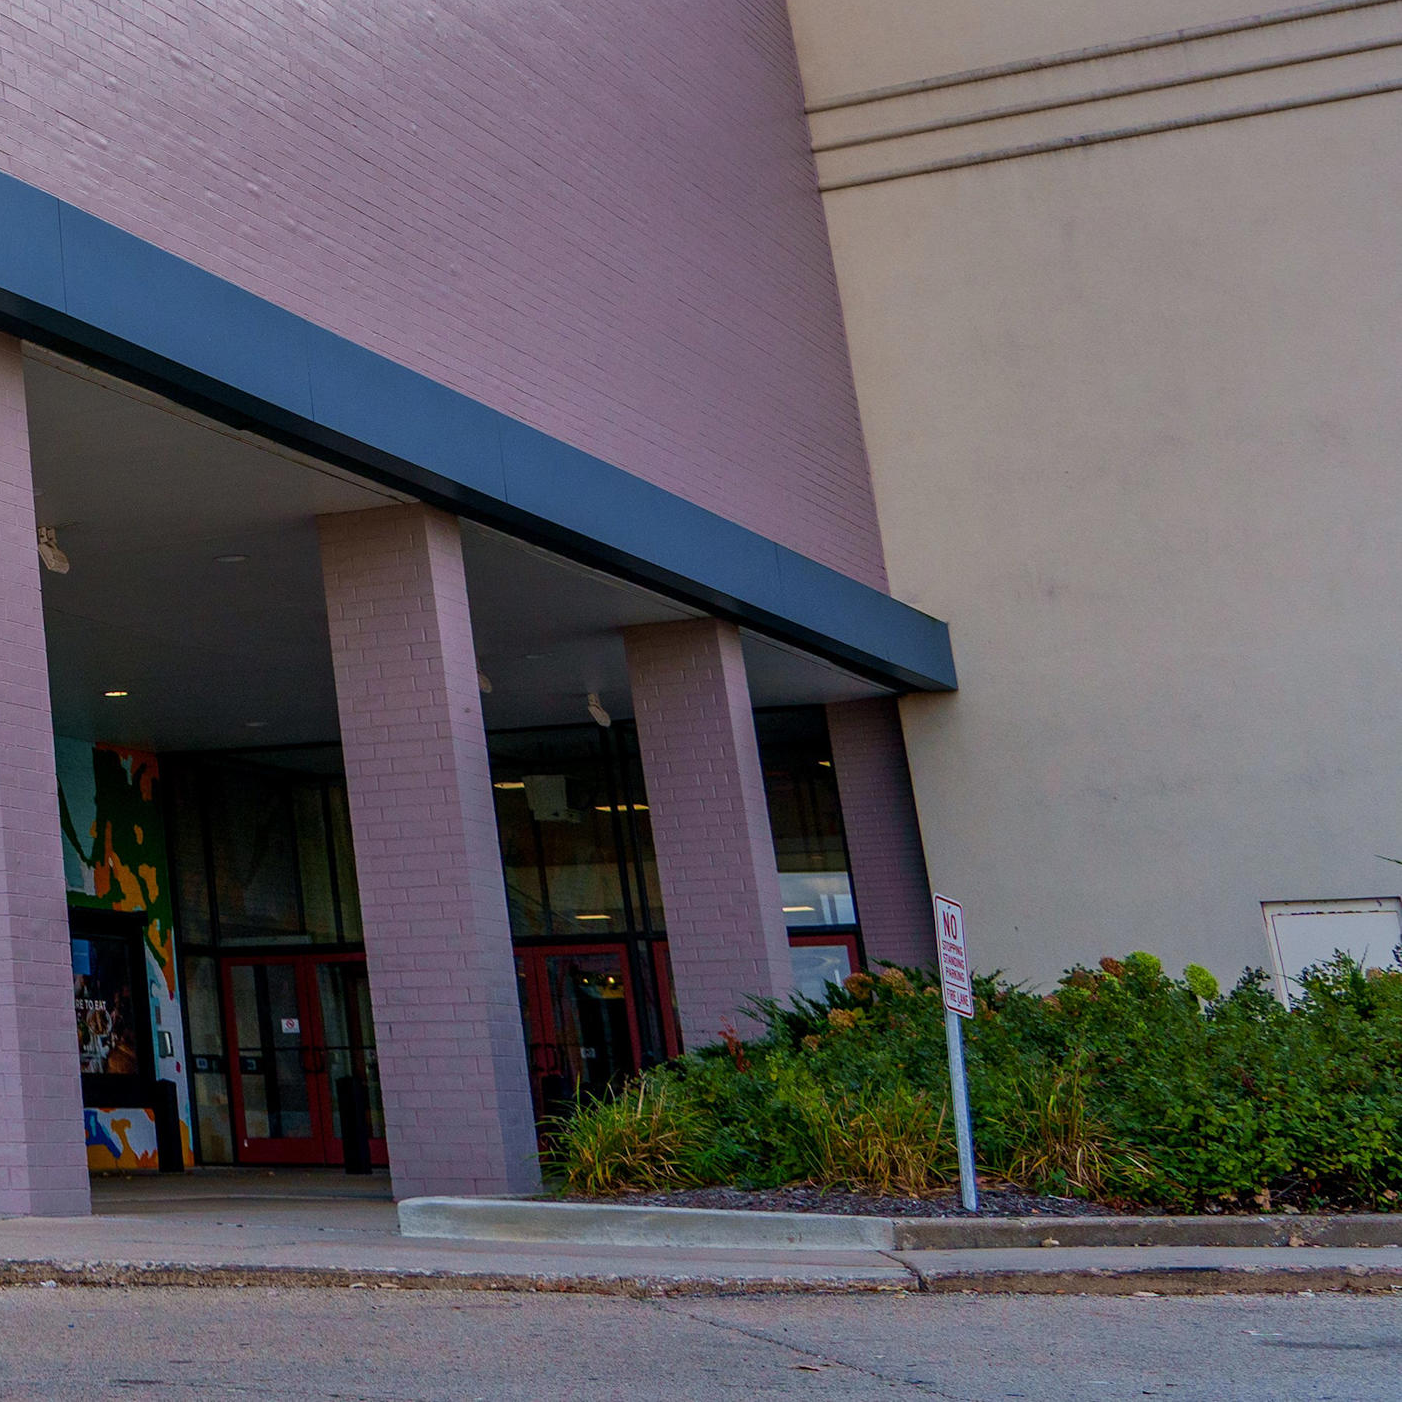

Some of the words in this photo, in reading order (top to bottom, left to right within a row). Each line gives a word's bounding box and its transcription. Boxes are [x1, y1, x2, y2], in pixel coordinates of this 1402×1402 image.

[942, 910, 957, 940] NO
[942, 940, 963, 957] STOPPING
[943, 953, 965, 971] STANDING
[945, 966, 965, 983] PARKING
[84, 998, 94, 1010] TO
[94, 999, 106, 1011] EAT
[947, 987, 957, 1003] FIRE
[957, 992, 970, 1007] LANE
